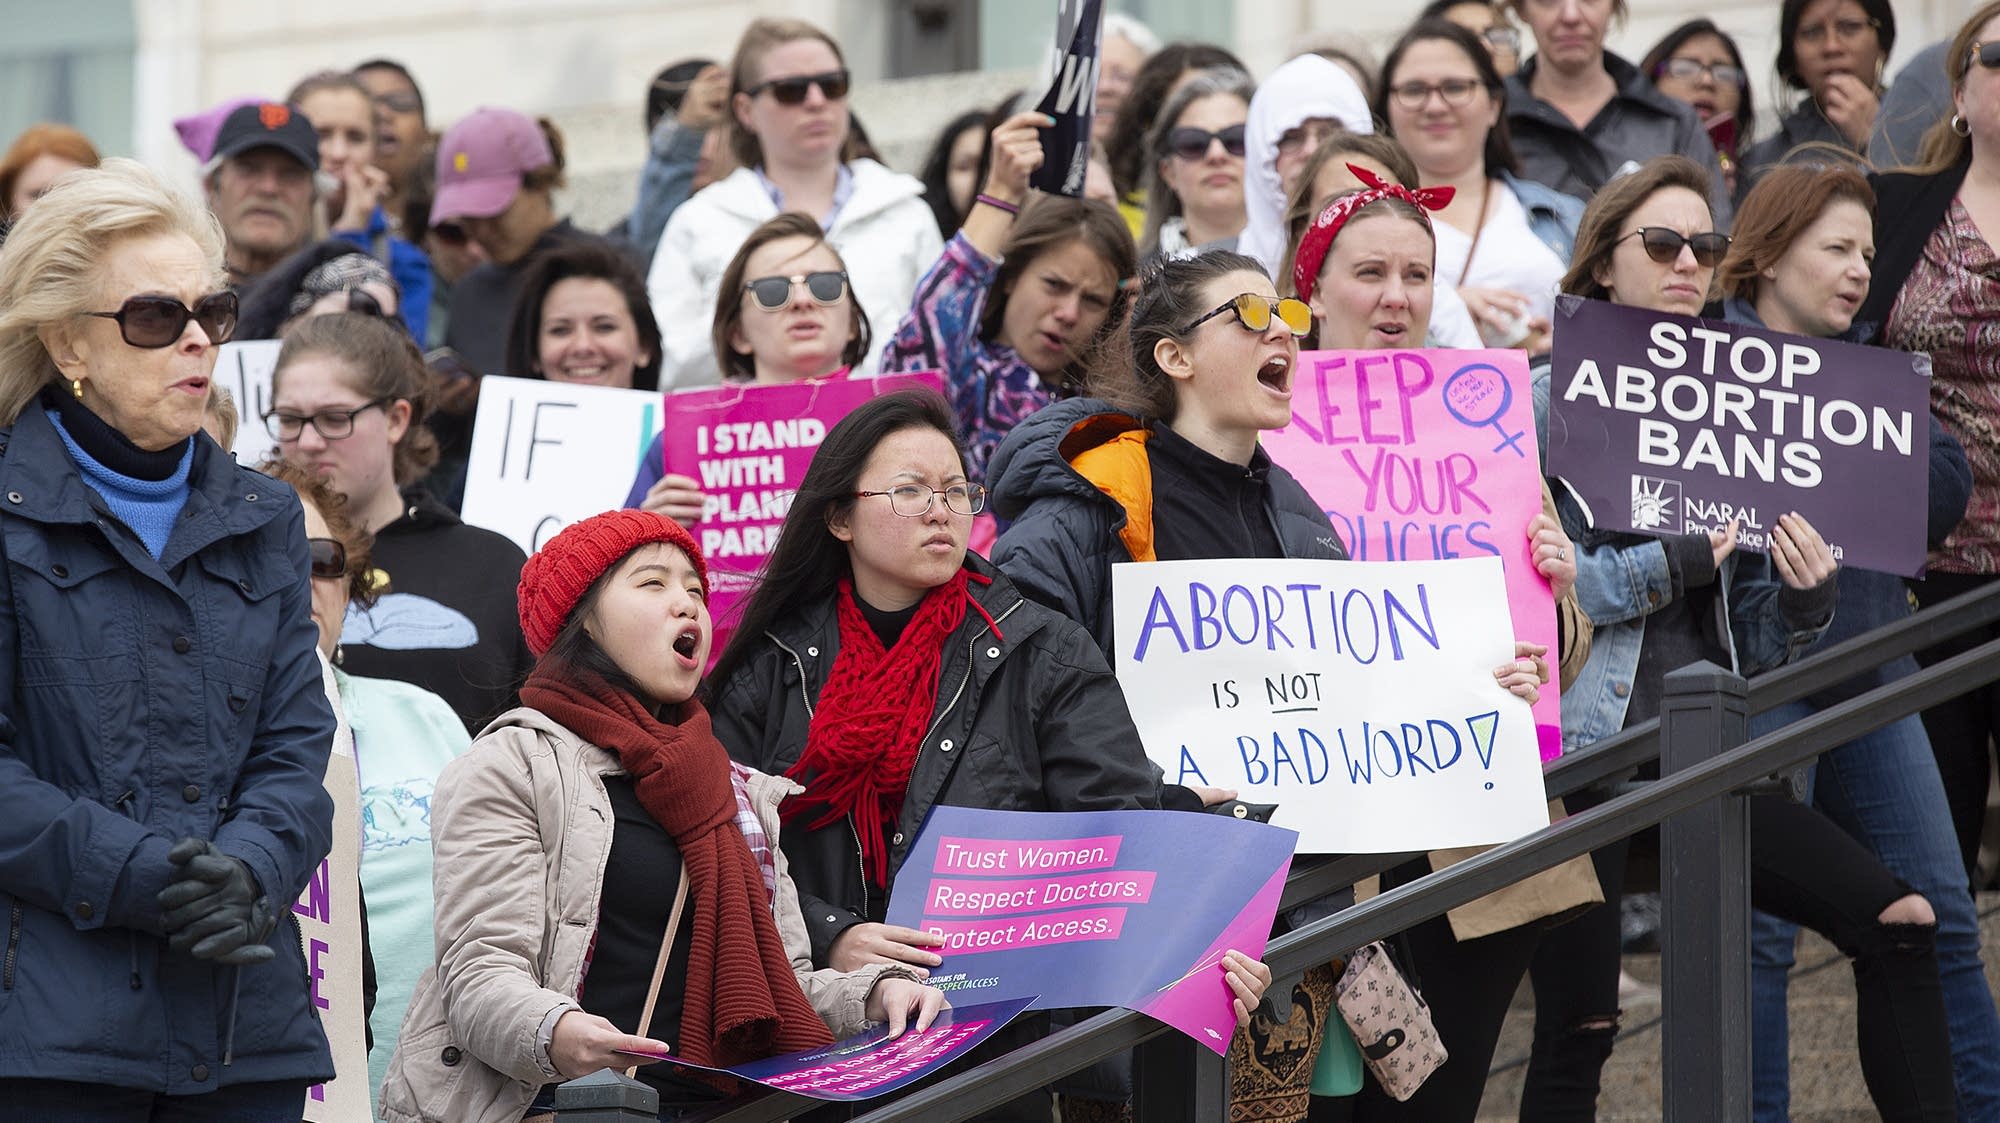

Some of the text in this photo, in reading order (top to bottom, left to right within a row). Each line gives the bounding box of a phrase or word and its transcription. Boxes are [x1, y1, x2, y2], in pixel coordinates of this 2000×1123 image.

[1647, 321, 1822, 389] STOP
[1563, 358, 1913, 457] ABORTION
[500, 398, 578, 481] IF
[697, 418, 826, 455] I STAND
[1637, 417, 1823, 488] BANS
[699, 455, 785, 489] WITH
[1341, 446, 1492, 516] YOUR
[1685, 496, 1763, 530] NARAL
[1132, 582, 1440, 665] ABORTION
[1212, 672, 1321, 709] IS NOT
[1178, 710, 1500, 790] A BAD WORD!
[945, 844, 1109, 869] Trust Women.
[934, 881, 1142, 914] Respect Doctors.
[1021, 918, 1113, 942] Access.
